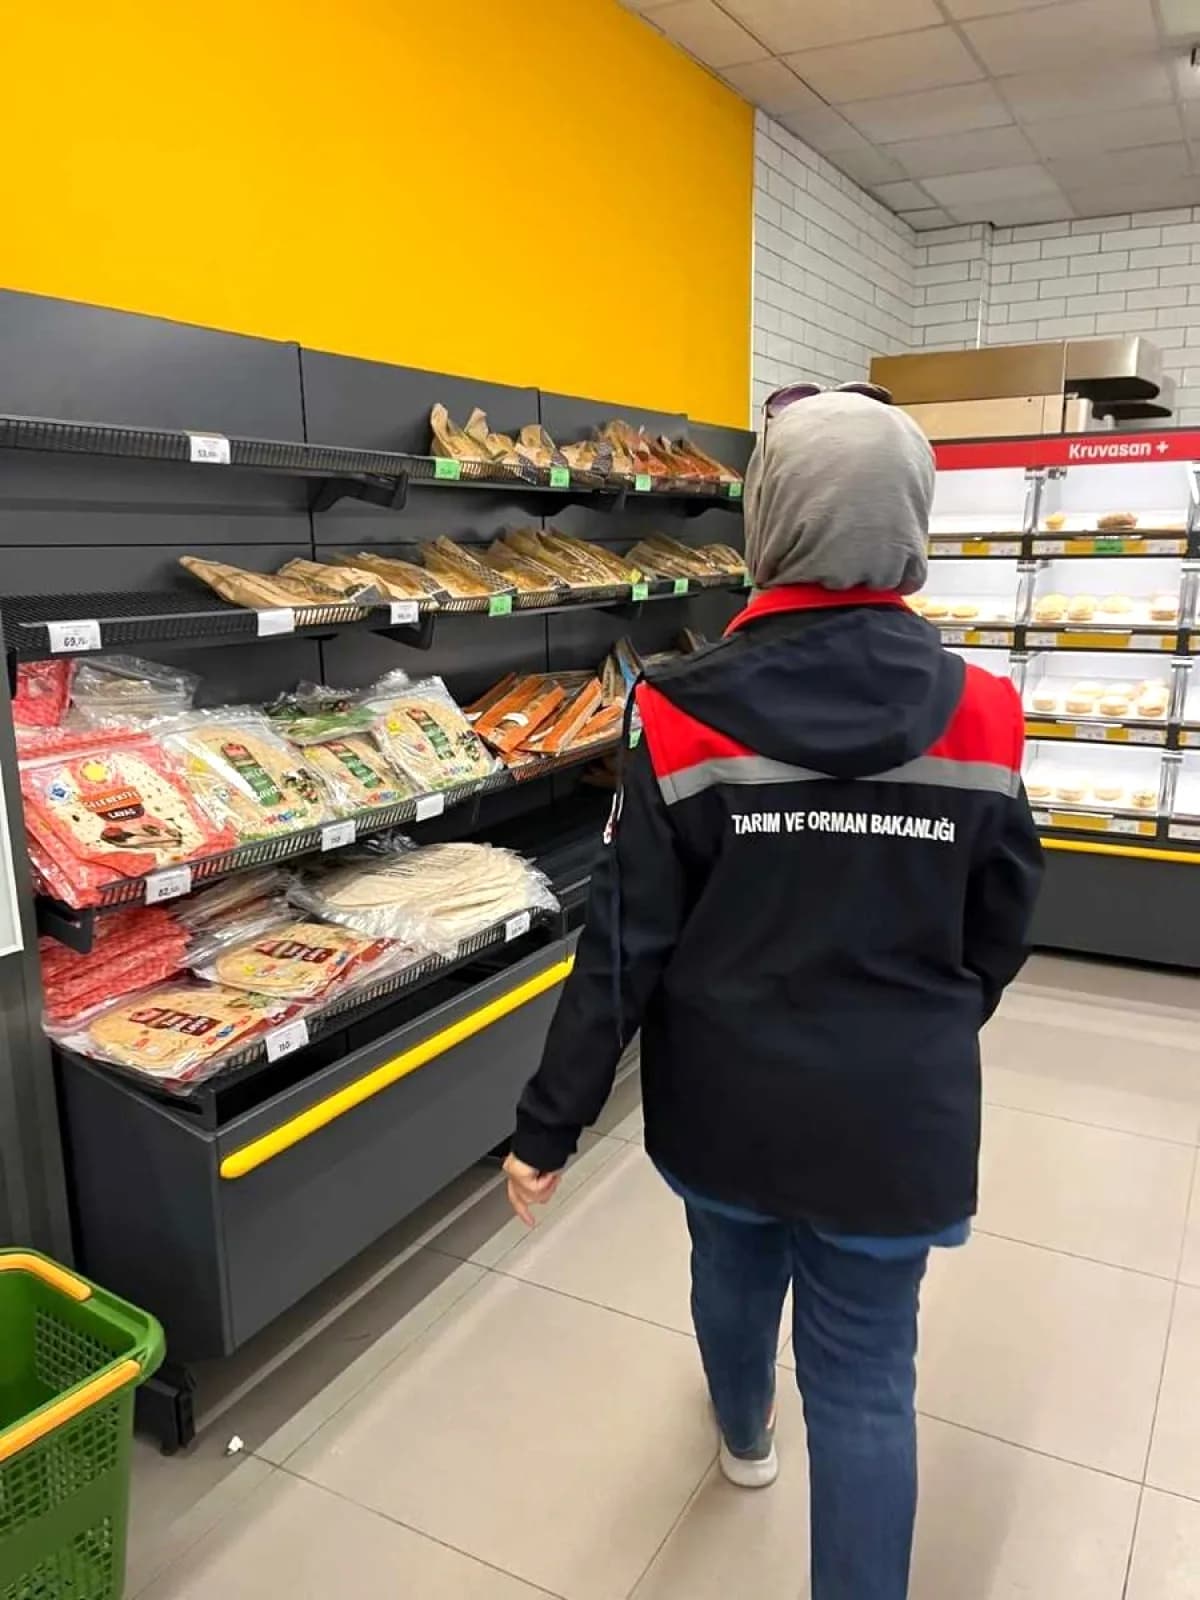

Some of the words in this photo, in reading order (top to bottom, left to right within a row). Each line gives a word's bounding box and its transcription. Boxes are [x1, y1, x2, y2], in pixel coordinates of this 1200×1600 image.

[1069, 441, 1151, 460] Kruvasan
[731, 812, 781, 834] TARIM
[783, 811, 806, 832] VE
[807, 810, 868, 834] ORMAN
[870, 814, 955, 842] BAKANLIĞI
